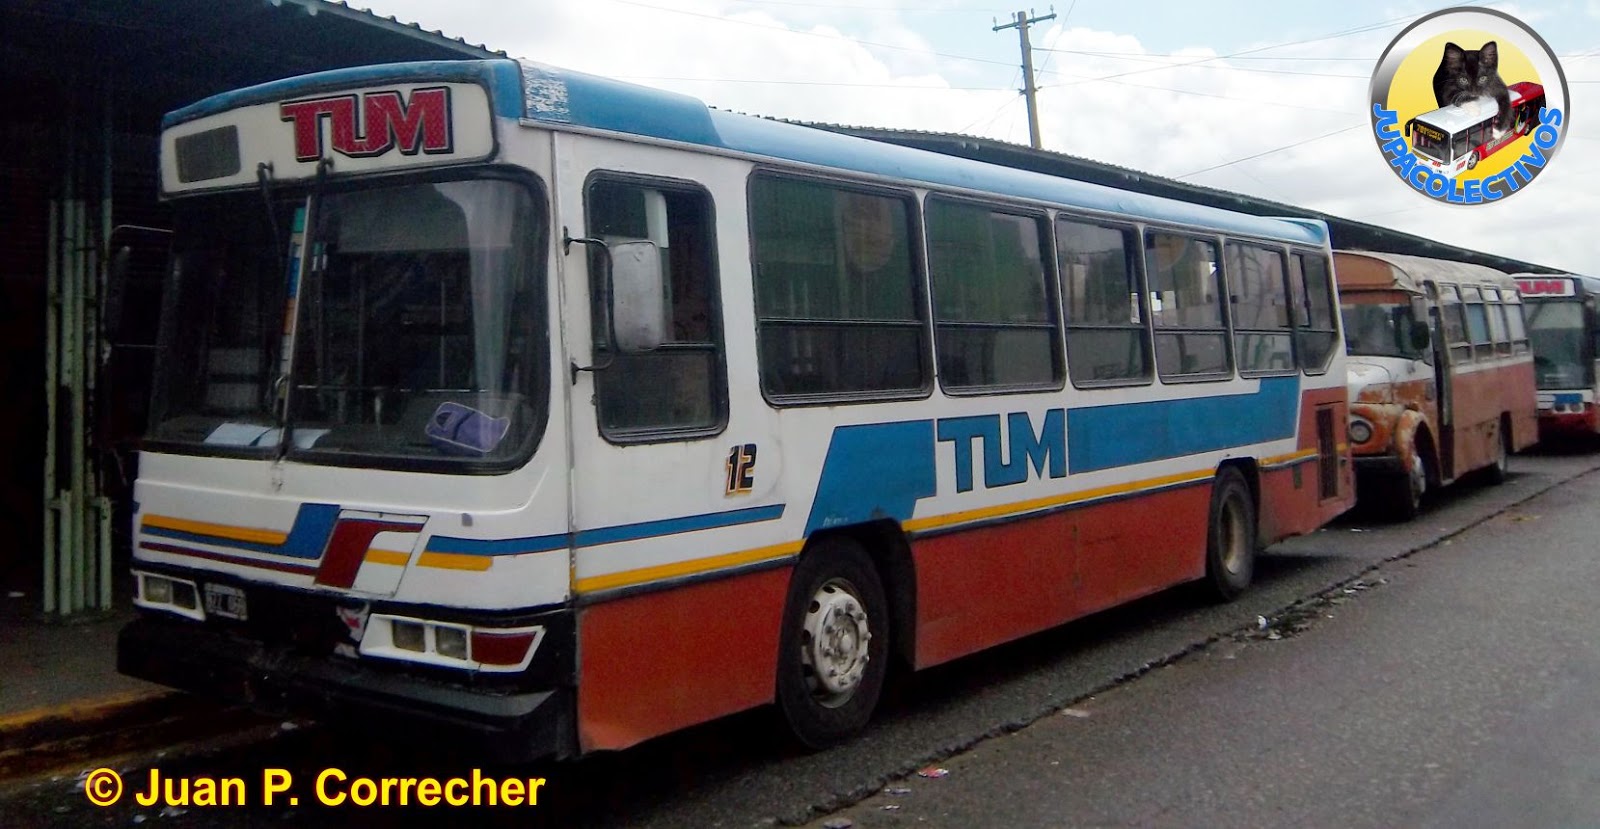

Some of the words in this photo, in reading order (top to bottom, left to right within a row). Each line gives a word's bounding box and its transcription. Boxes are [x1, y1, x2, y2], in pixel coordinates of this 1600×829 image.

[281, 86, 454, 162] TUM
[1516, 279, 1564, 295] UM
[725, 443, 757, 496] 12
[937, 408, 1067, 493] TUM
